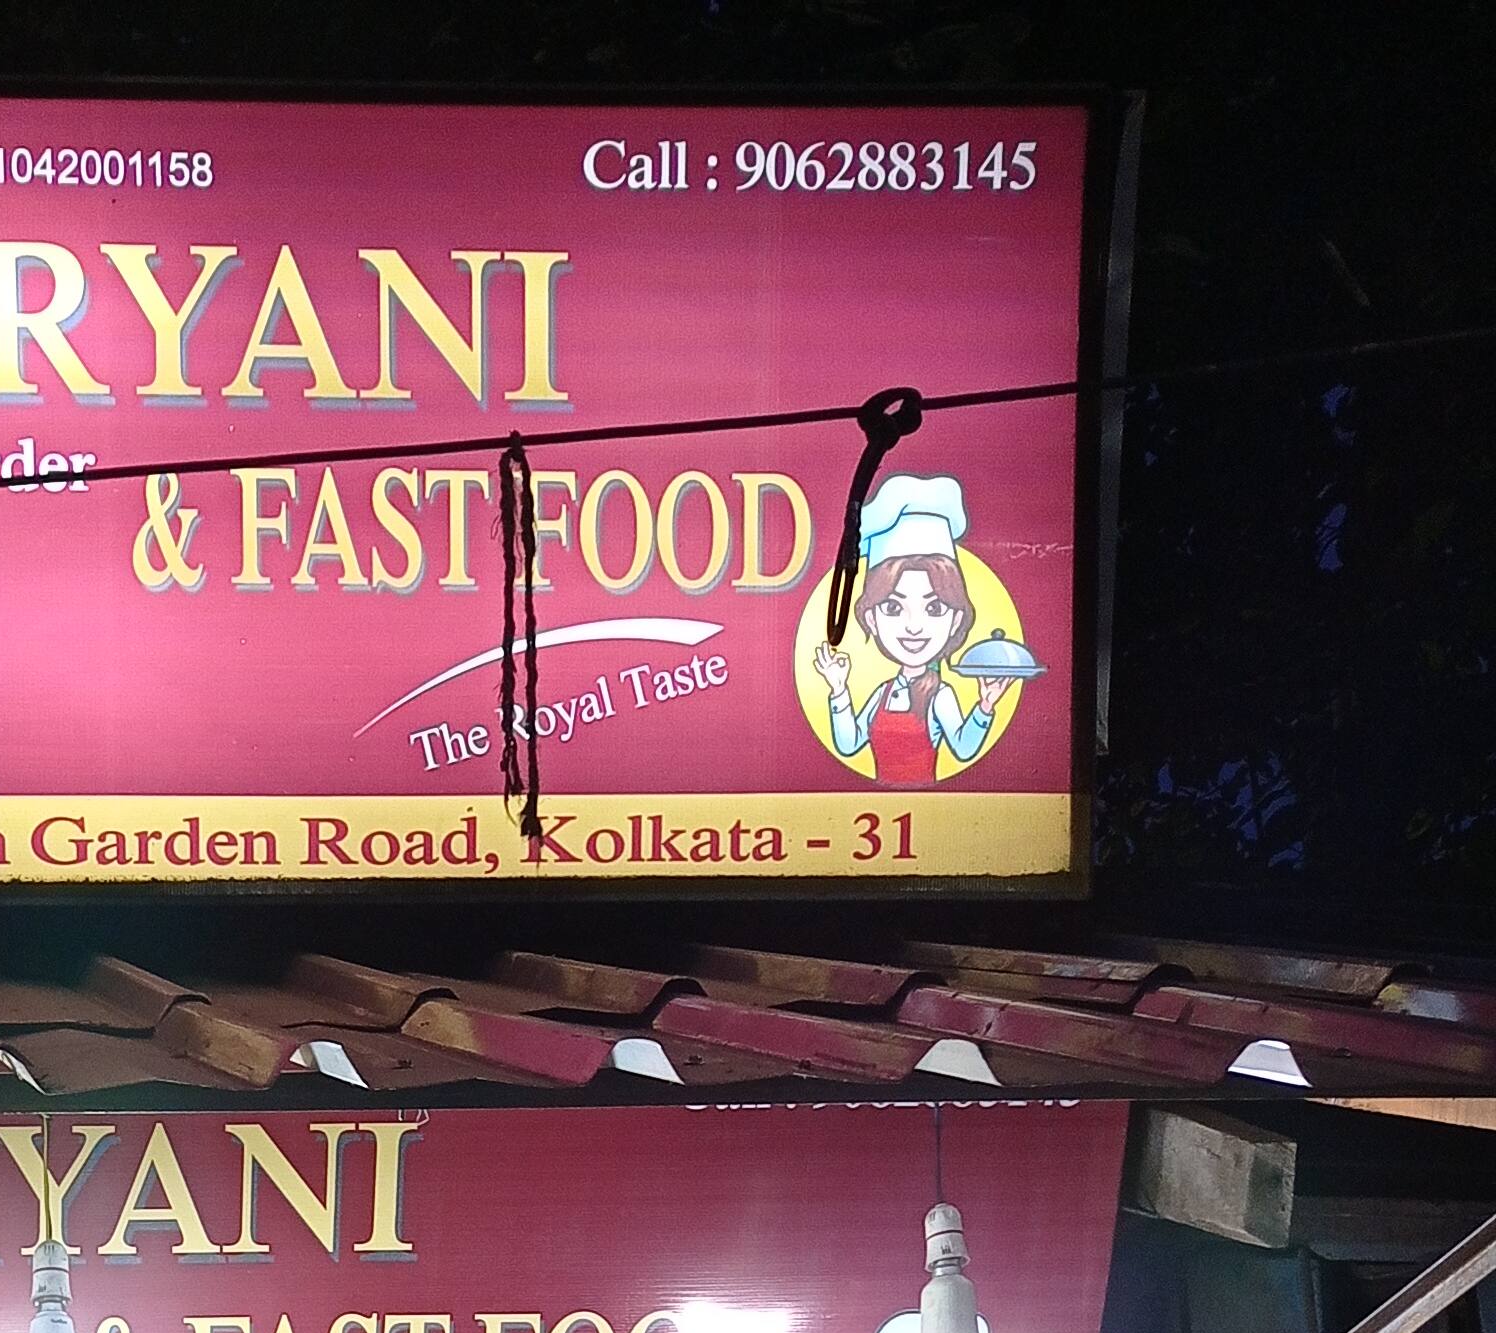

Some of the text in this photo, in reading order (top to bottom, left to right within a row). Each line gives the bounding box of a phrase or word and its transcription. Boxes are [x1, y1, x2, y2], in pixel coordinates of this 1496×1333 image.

[582, 140, 1038, 193] Call 9062883145
[130, 464, 815, 596] & FAST FOOD
[409, 721, 491, 772] The
[619, 653, 730, 711] Taste
[30, 815, 282, 868] Garden
[299, 813, 501, 875] Road,
[518, 812, 786, 866] Kolkata
[851, 810, 919, 864] 31
